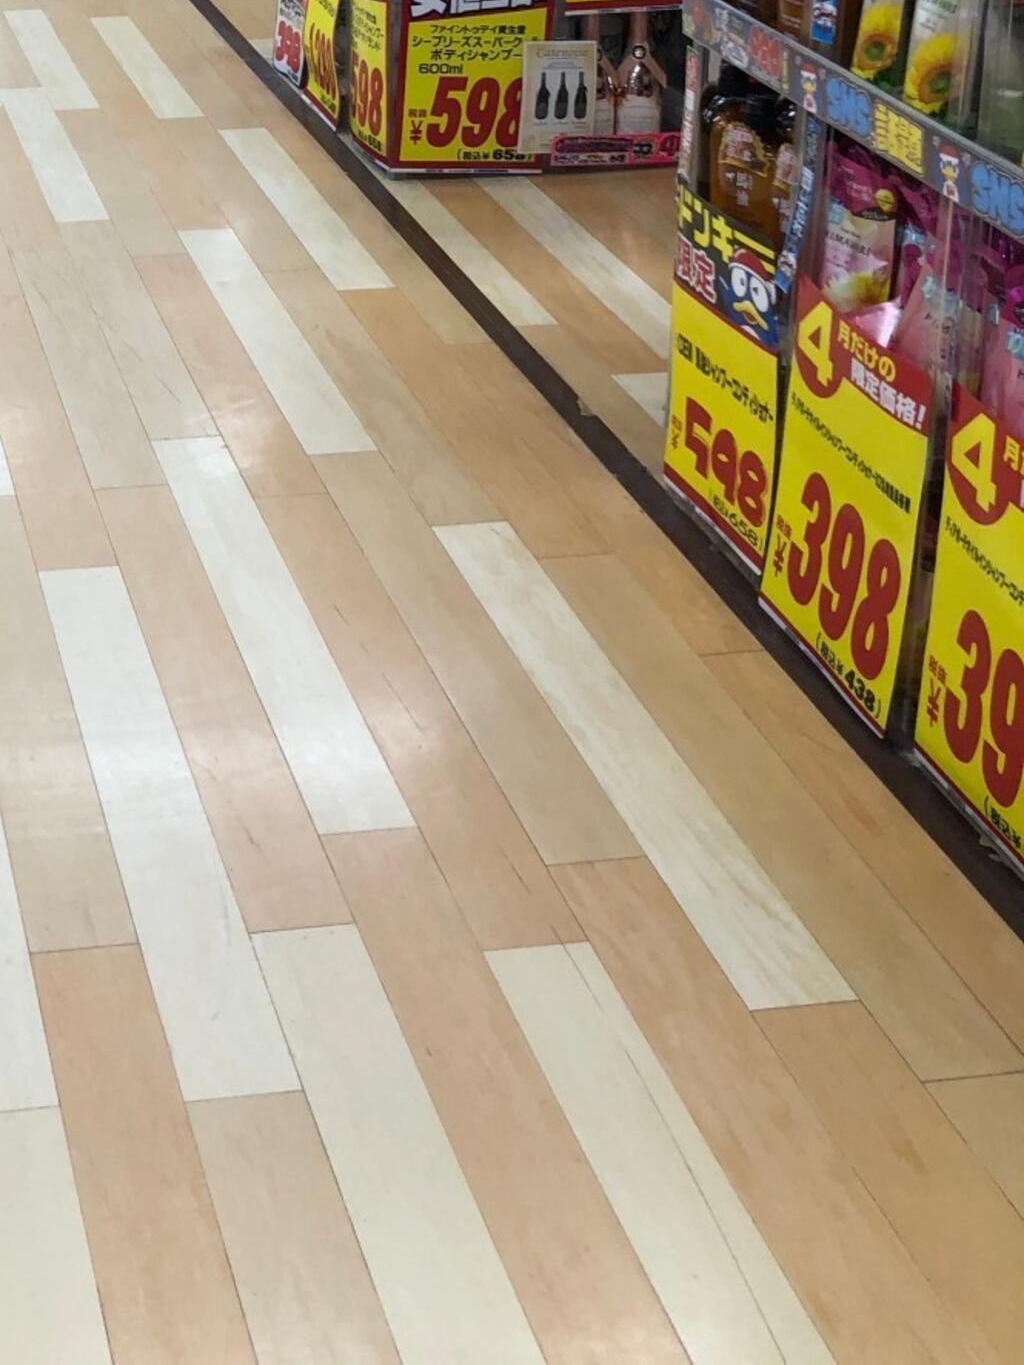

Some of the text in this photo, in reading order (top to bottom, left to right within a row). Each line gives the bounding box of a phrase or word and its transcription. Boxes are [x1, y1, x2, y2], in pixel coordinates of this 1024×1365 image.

[418, 62, 464, 75] 600ml
[430, 49, 522, 62] ボディシャンプー
[409, 120, 424, 146] ¥
[426, 75, 523, 148] 598
[677, 184, 736, 264] ドンキ
[677, 234, 718, 305] 限定
[796, 298, 837, 387] 4
[836, 320, 898, 385] 月だけの
[849, 357, 929, 432] 限定価格!
[684, 395, 770, 529] 598
[950, 412, 999, 516] 4
[787, 472, 903, 682] 398
[942, 608, 1024, 809] 39
